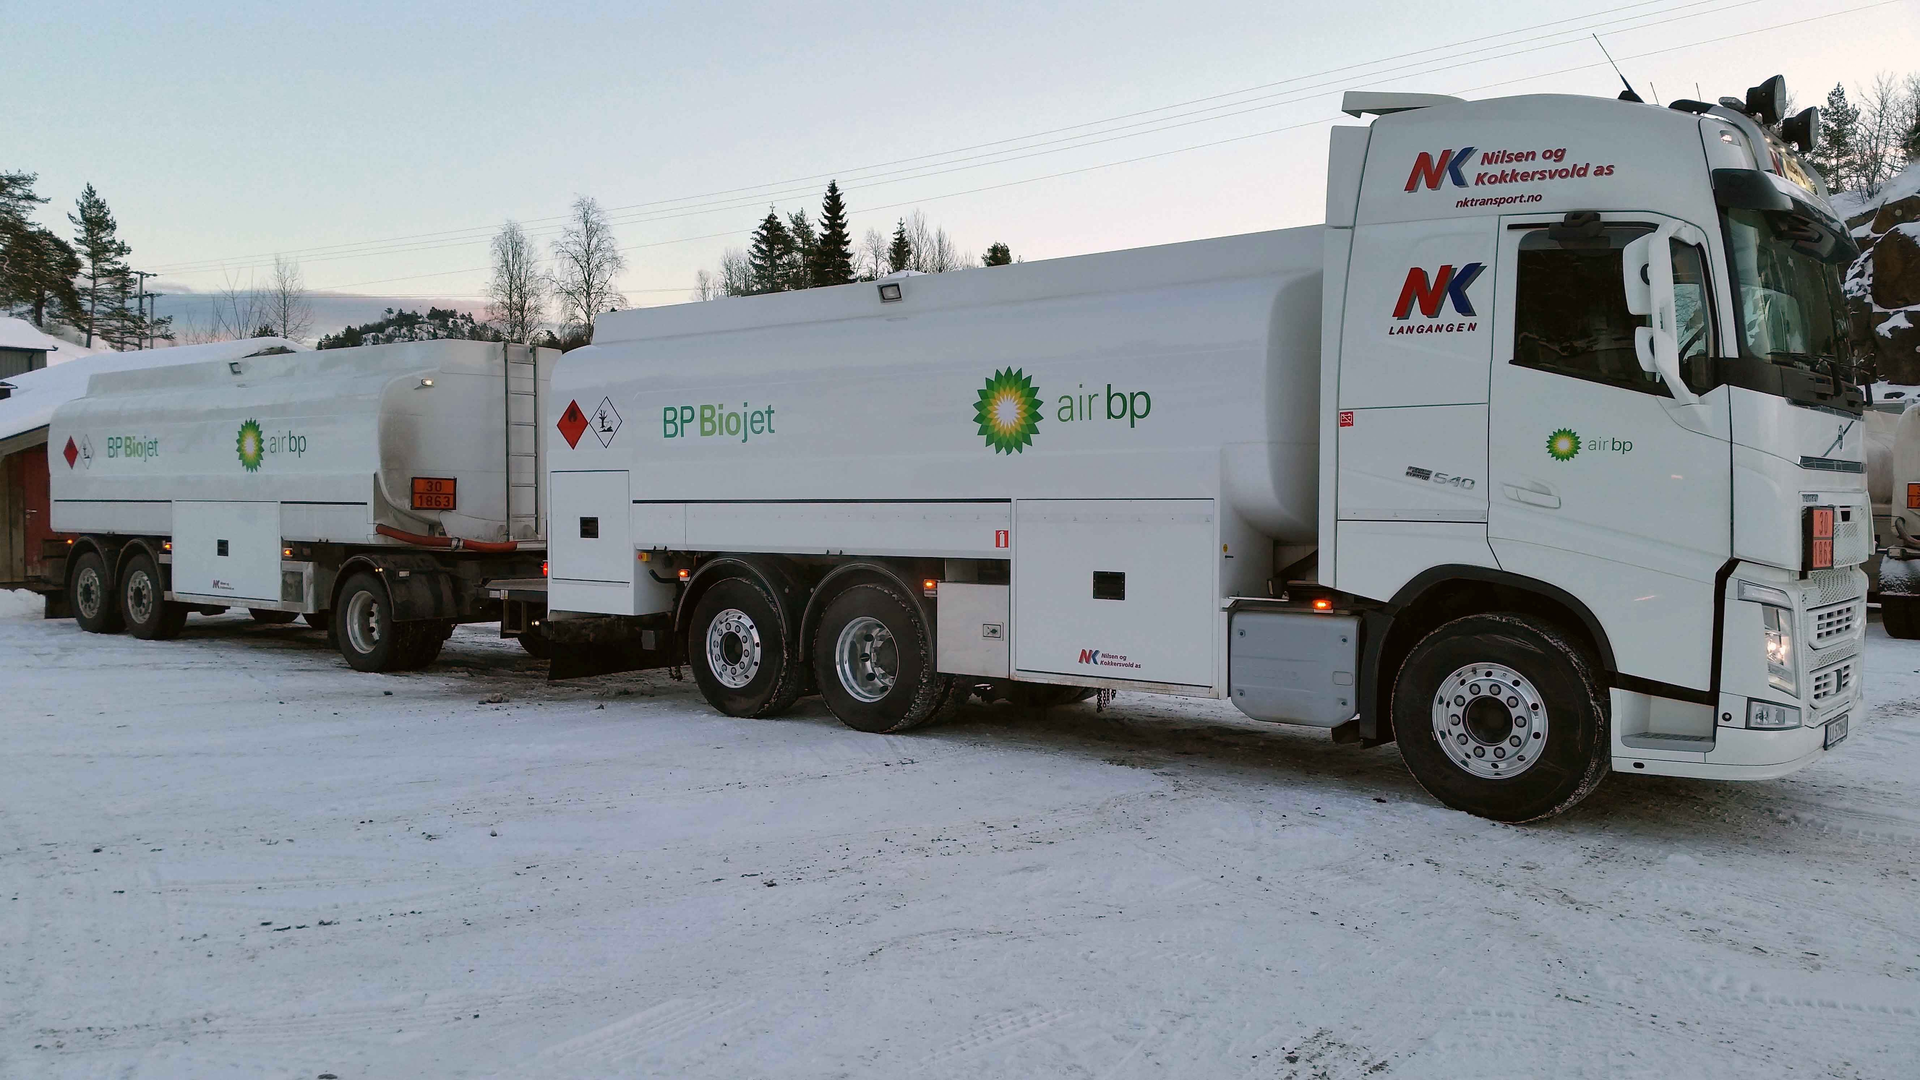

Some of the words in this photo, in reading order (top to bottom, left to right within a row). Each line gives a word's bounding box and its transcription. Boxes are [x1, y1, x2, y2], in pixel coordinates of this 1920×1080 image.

[1480, 150, 1536, 167] Nilsen
[1541, 147, 1567, 163] og
[1404, 146, 1478, 193] NK
[1474, 163, 1590, 187] Kokkersvold
[1592, 164, 1615, 177] as
[1455, 193, 1543, 209] nktransport.no
[1392, 262, 1487, 320] NK
[1388, 322, 1478, 336] LANGANGEN
[663, 405, 695, 439] BP
[700, 402, 775, 444] Biojet
[426, 480, 443, 493] 30
[1432, 471, 1476, 491] 540
[418, 495, 451, 508] 1863
[1818, 511, 1829, 535] 30
[1815, 541, 1832, 566] 1863
[1078, 648, 1100, 665] NK
[1100, 660, 1134, 668] Kokkersvold
